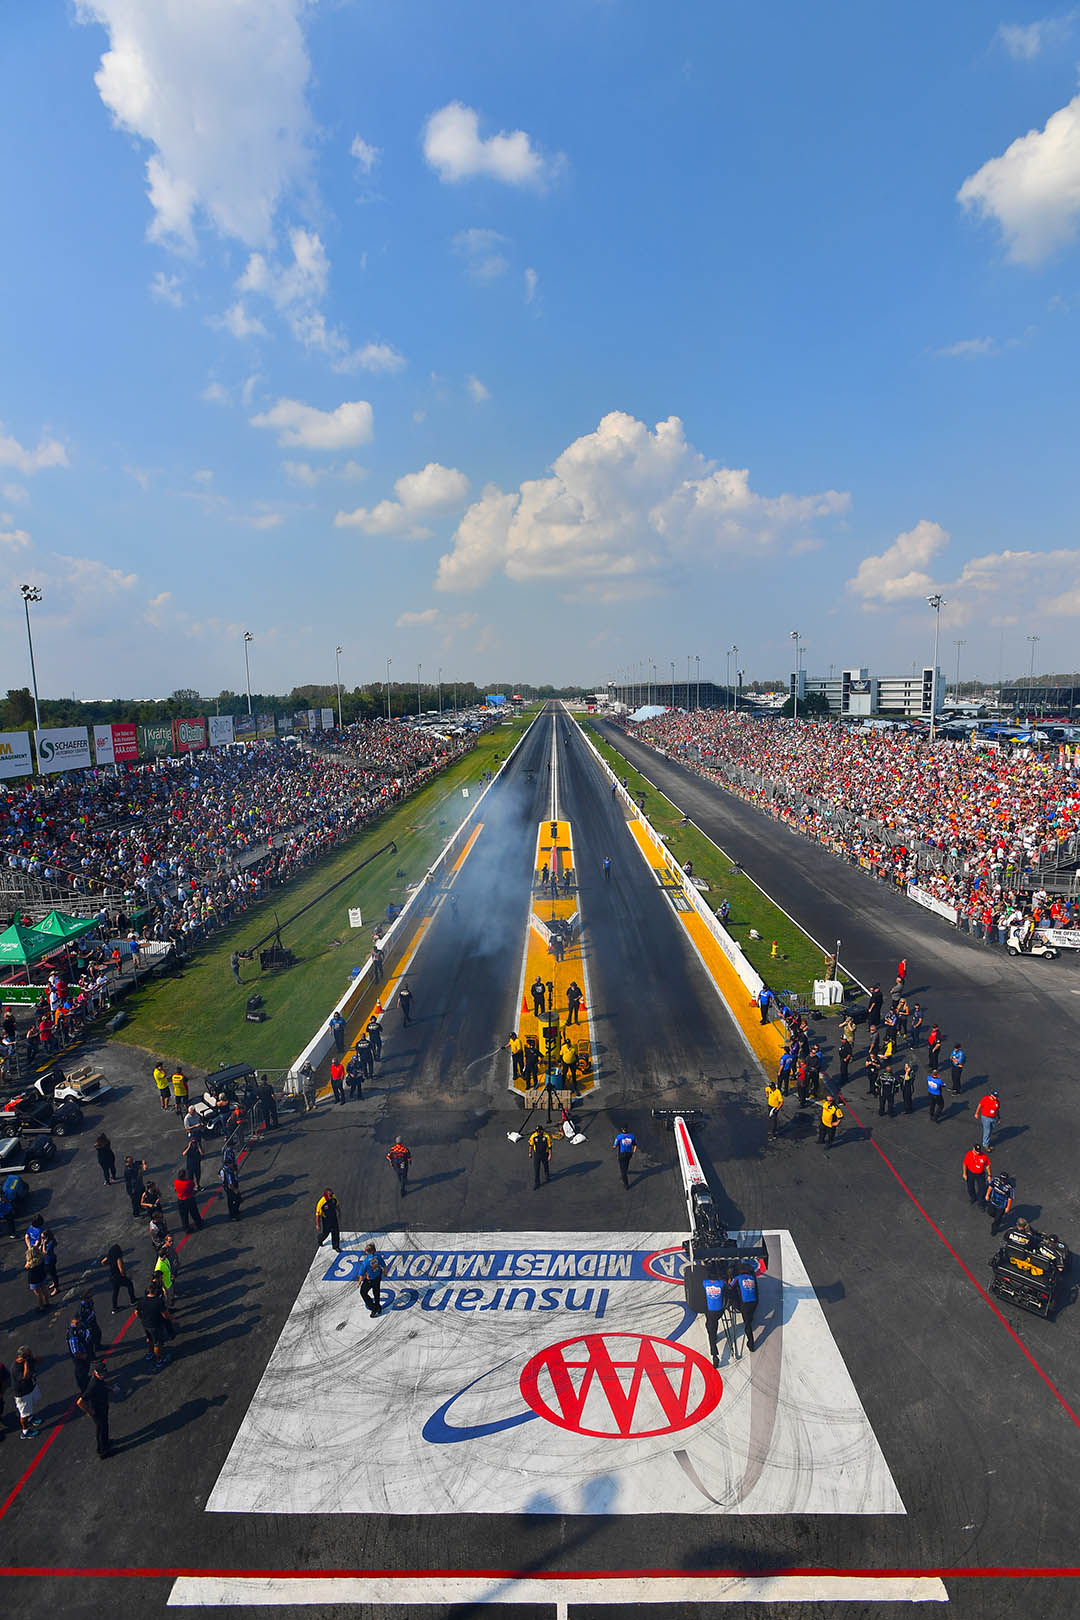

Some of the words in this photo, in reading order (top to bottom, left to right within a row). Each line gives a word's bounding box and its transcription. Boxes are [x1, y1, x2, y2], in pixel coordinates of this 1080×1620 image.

[147, 728, 172, 741] Kräftig
[54, 739, 88, 750] SCHAEFER
[497, 1253, 633, 1277] MIDWEST
[365, 1286, 610, 1319] Insurance
